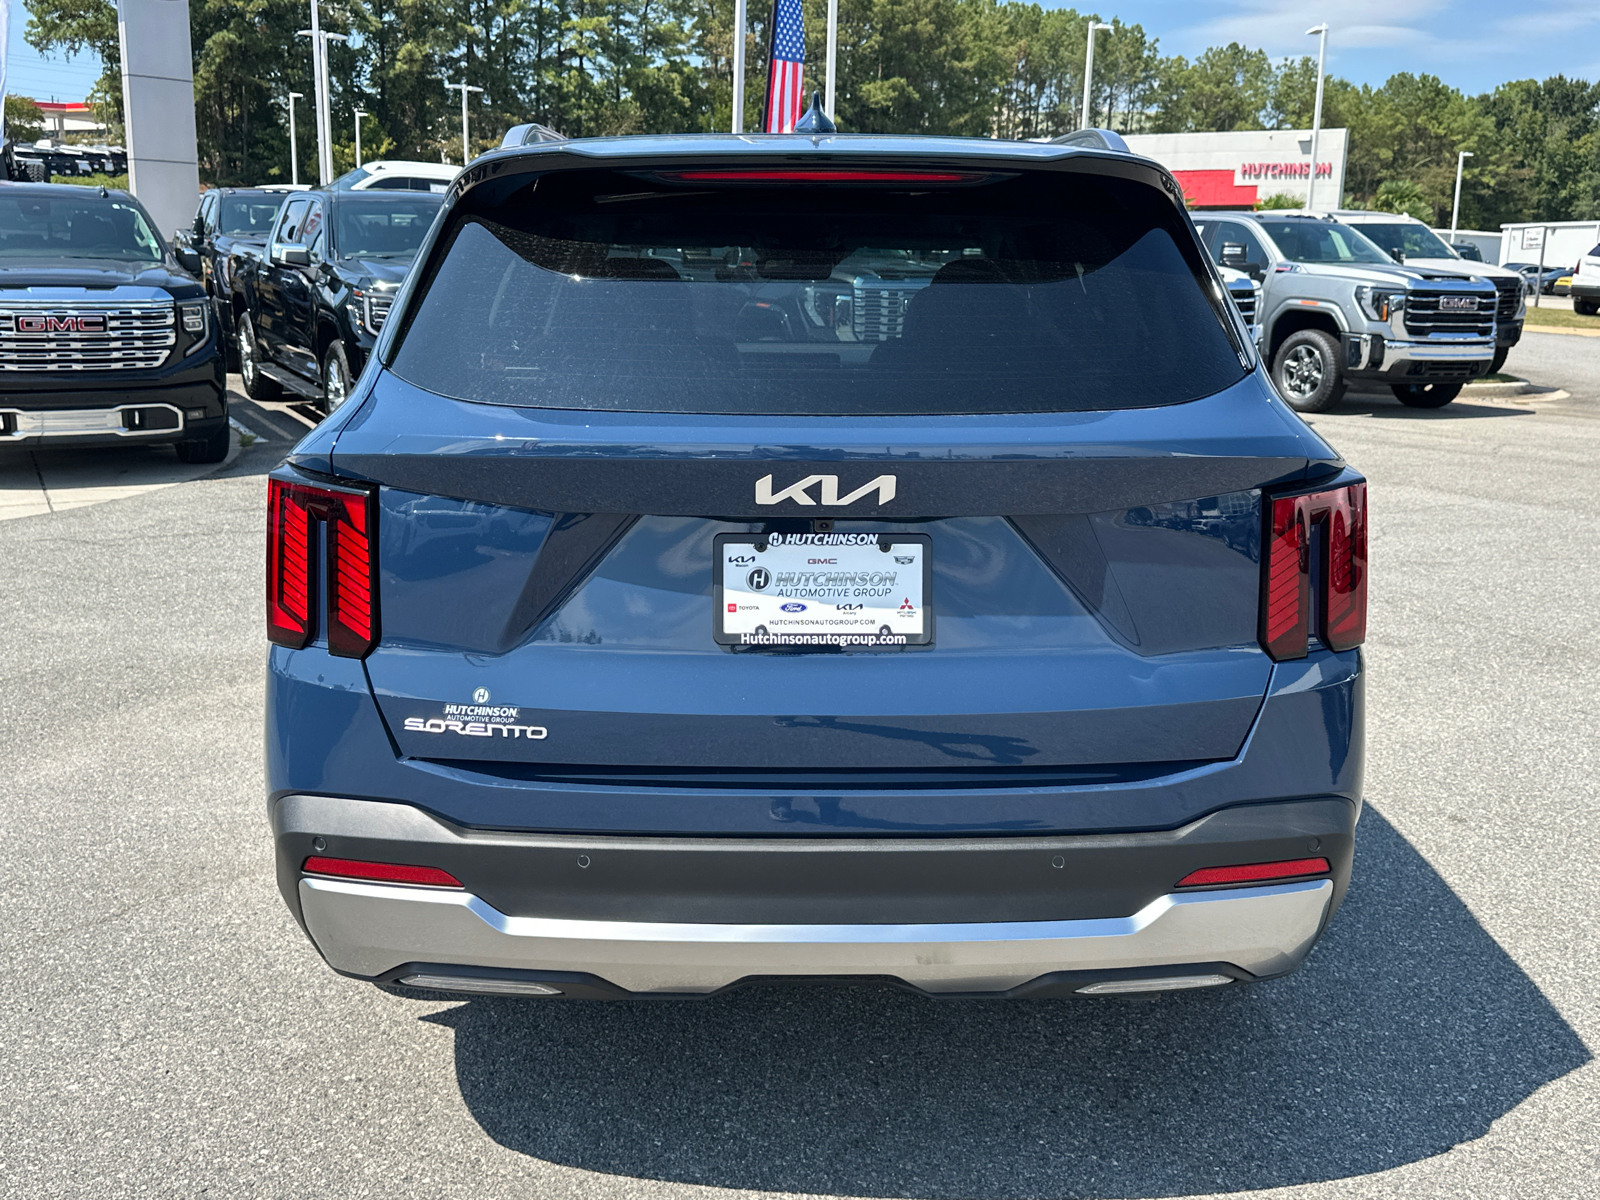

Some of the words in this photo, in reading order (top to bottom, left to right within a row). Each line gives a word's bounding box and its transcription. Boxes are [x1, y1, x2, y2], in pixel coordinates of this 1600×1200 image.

[19, 316, 104, 332] GMC
[755, 473, 897, 506] KIA
[785, 533, 879, 546] HUTCHINSON
[728, 555, 755, 563] KIA
[775, 571, 897, 587] HUTCHINSON
[777, 587, 850, 598] AUTOMOTIVE
[853, 587, 892, 598] GROUP
[836, 603, 864, 611] KIA
[740, 632, 907, 647] Hutchinsonautogroup.com
[444, 704, 518, 718] HUTCHINSON
[446, 714, 490, 723] AUTOMOTIVE
[491, 716, 515, 724] GROUP
[403, 717, 548, 740] SORENTO
